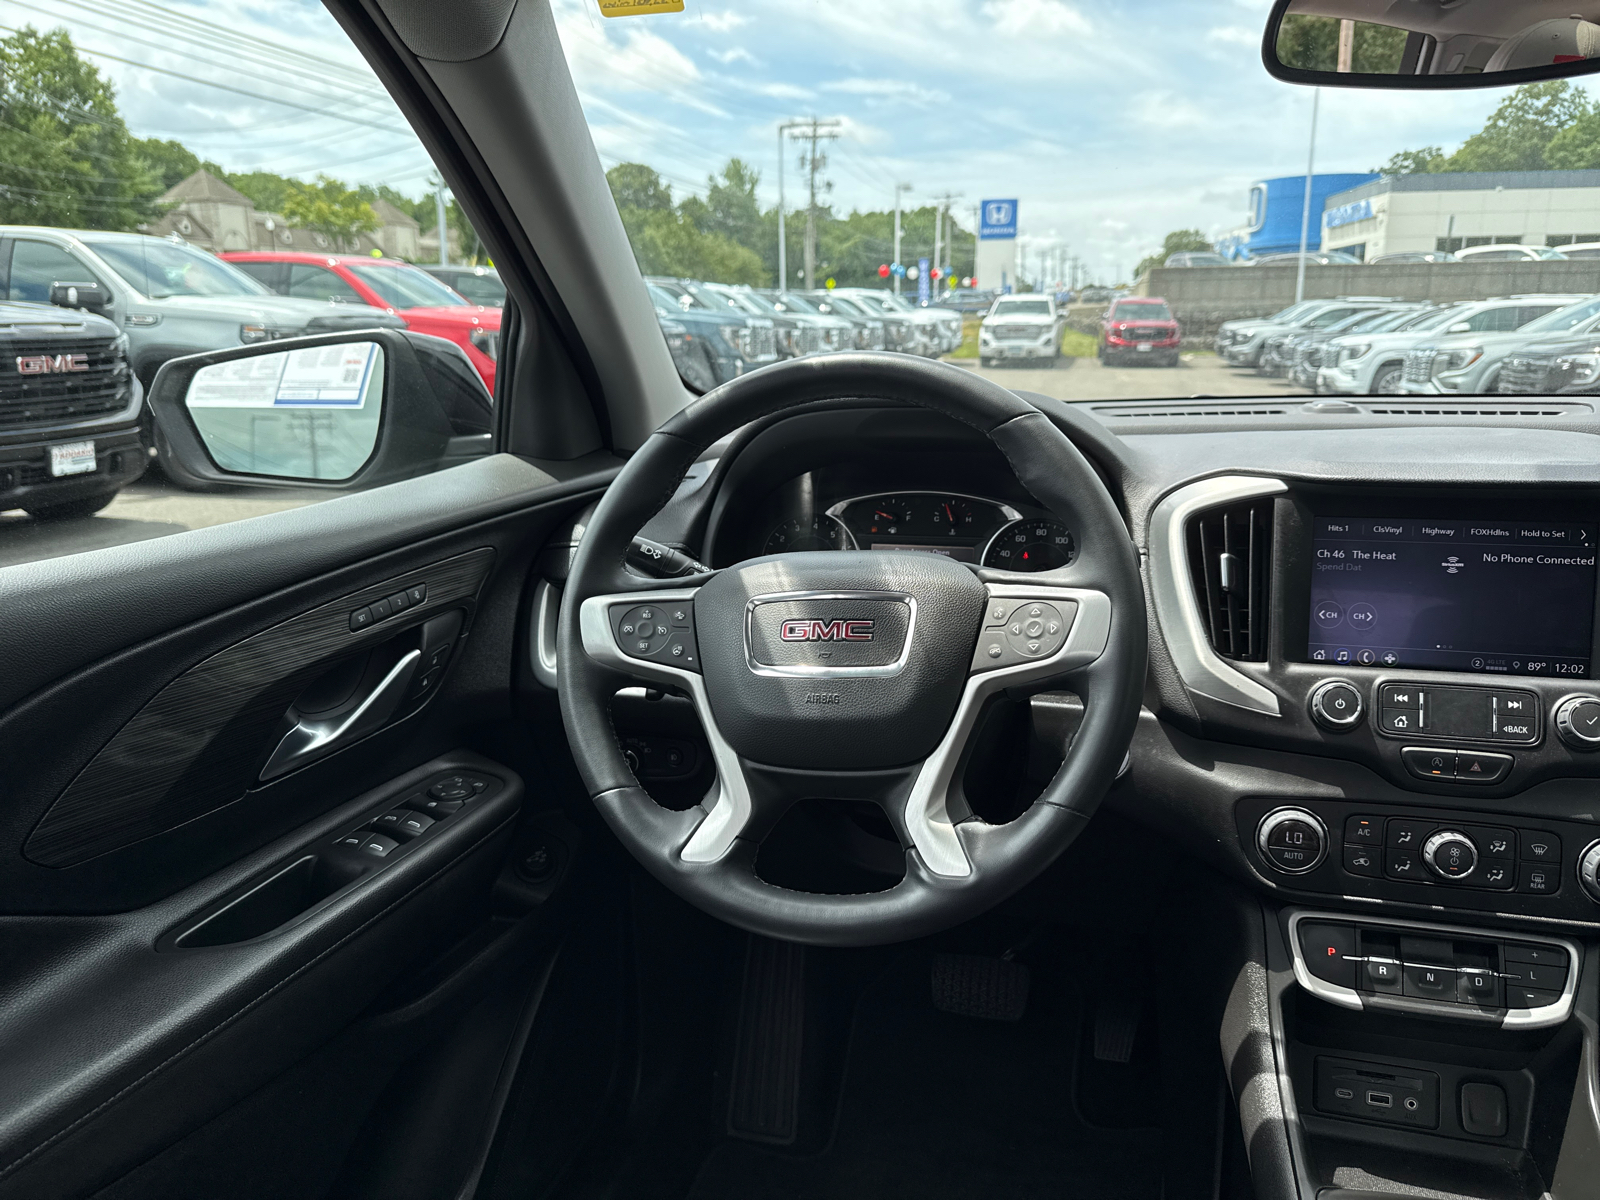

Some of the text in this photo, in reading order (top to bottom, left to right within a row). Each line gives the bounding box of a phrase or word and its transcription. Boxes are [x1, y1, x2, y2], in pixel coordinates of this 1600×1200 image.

[16, 354, 89, 374] GMC
[1373, 526, 1403, 535] ClsVinyl
[1422, 527, 1455, 537] Highway
[1470, 528, 1509, 536] FOXHdlns
[1521, 529, 1540, 537] Hold
[1317, 549, 1397, 560] Ch 46 The Heat
[1483, 553, 1595, 565] No Phone Connected
[1316, 562, 1362, 572] Spend Dat
[358, 614, 366, 622] SET
[781, 620, 874, 641] GMC
[1527, 662, 1547, 671] 89°
[1555, 663, 1584, 674] 12:02
[805, 693, 840, 705] AIRBAG
[1508, 726, 1528, 734] BACK
[1286, 831, 1303, 844] LO
[1283, 851, 1304, 860] AUTO
[1327, 947, 1336, 956] P
[1379, 966, 1387, 975] R
[1426, 973, 1434, 982] N
[1530, 971, 1536, 980] L
[1475, 977, 1483, 986] D
